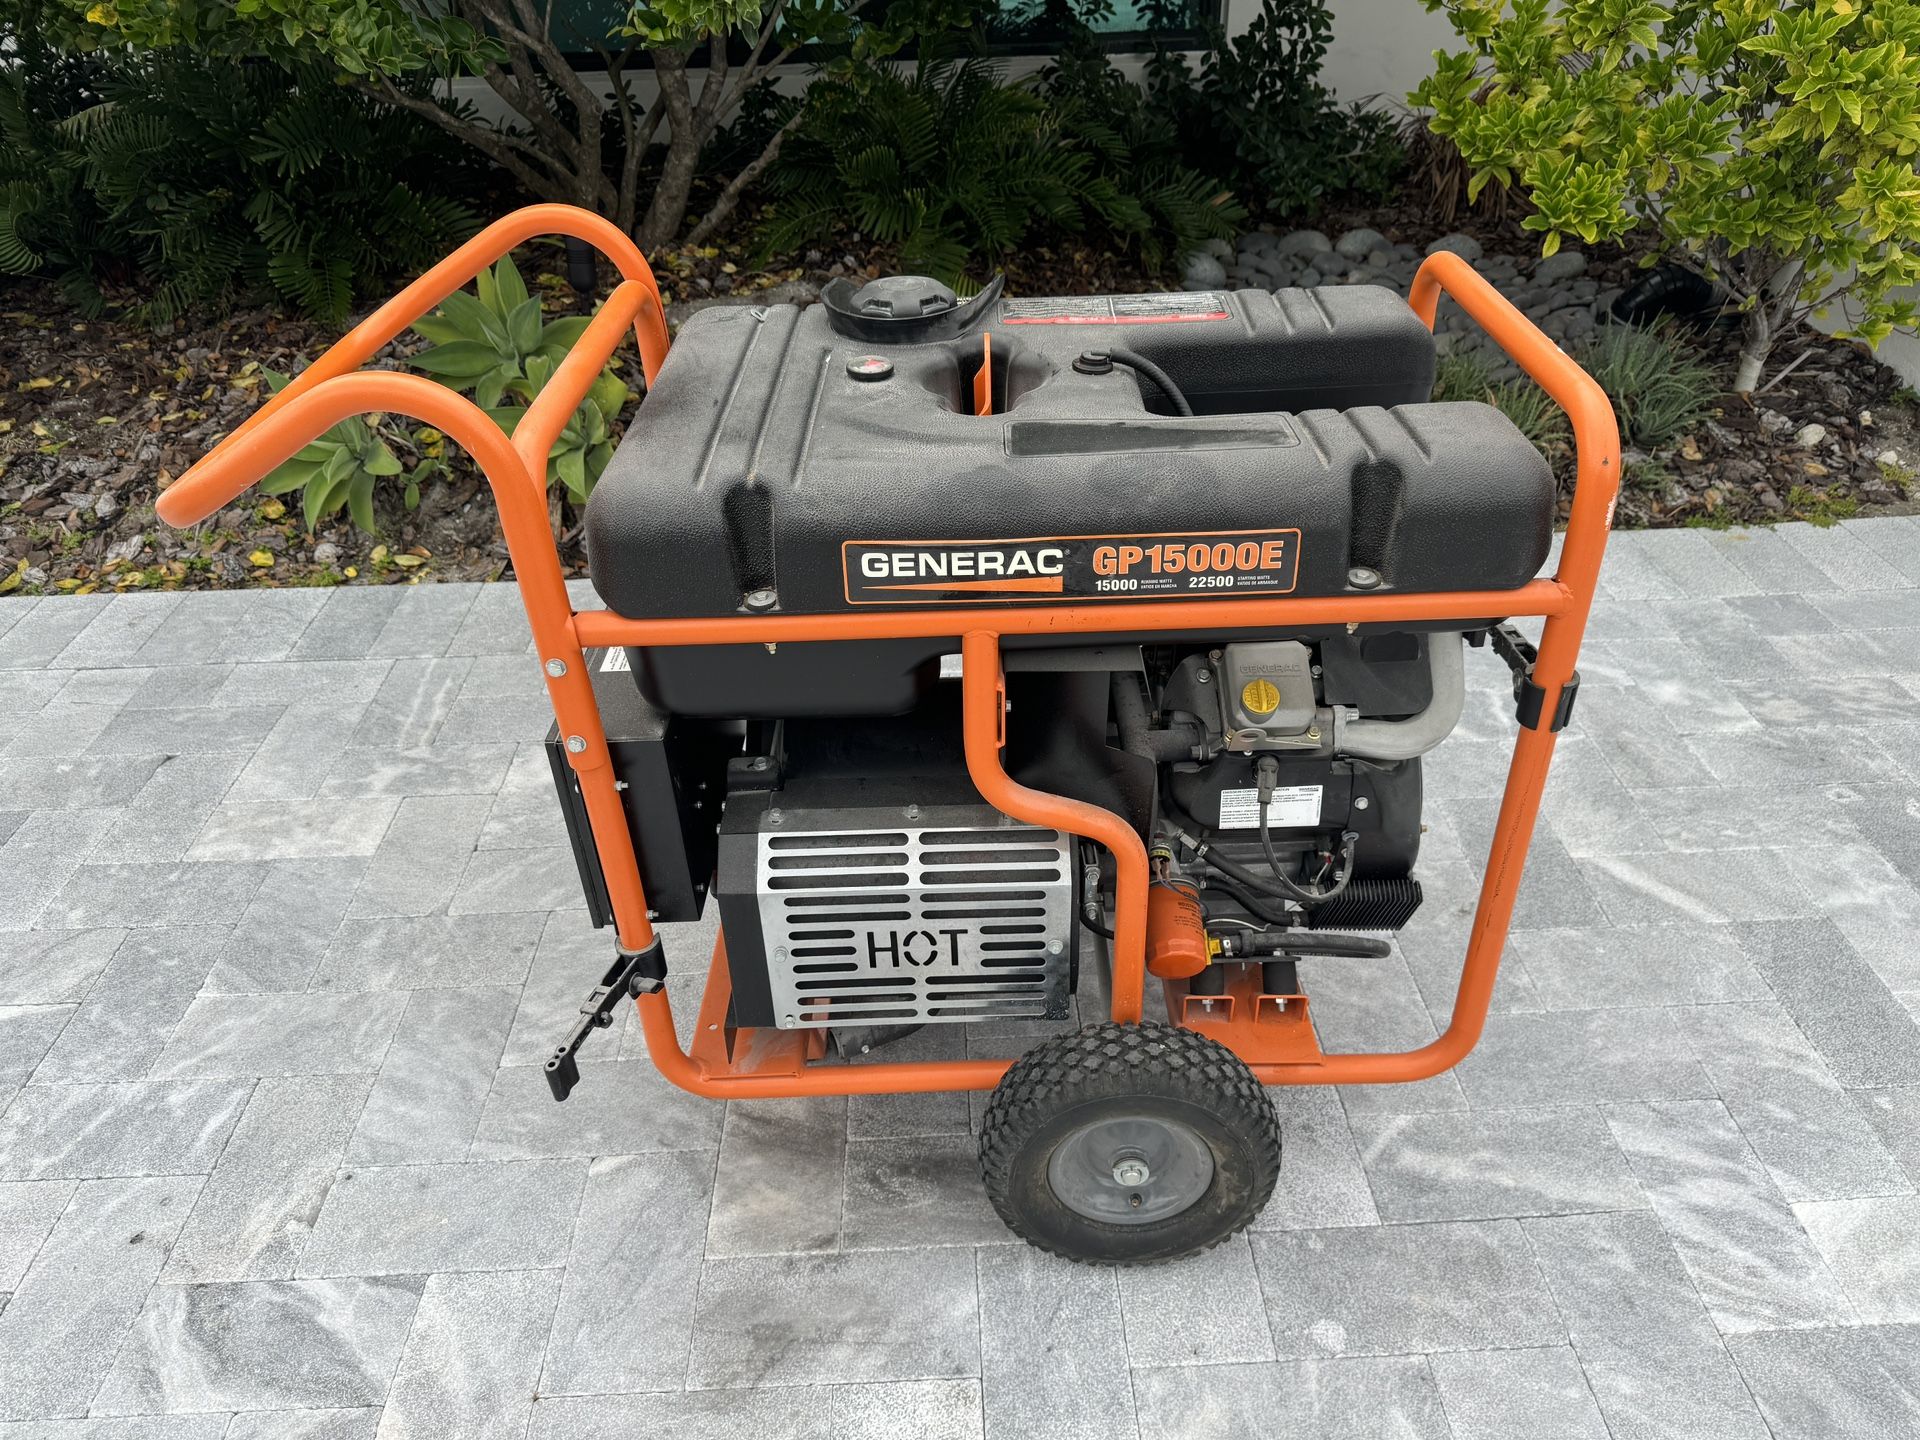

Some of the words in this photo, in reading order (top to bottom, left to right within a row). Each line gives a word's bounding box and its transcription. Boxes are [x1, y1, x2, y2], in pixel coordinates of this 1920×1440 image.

[861, 549, 1064, 578] GENERAC
[1092, 541, 1284, 576] GP15000E
[1095, 579, 1138, 591] 15000
[1189, 575, 1235, 588] 22500
[867, 929, 968, 968] HOT
